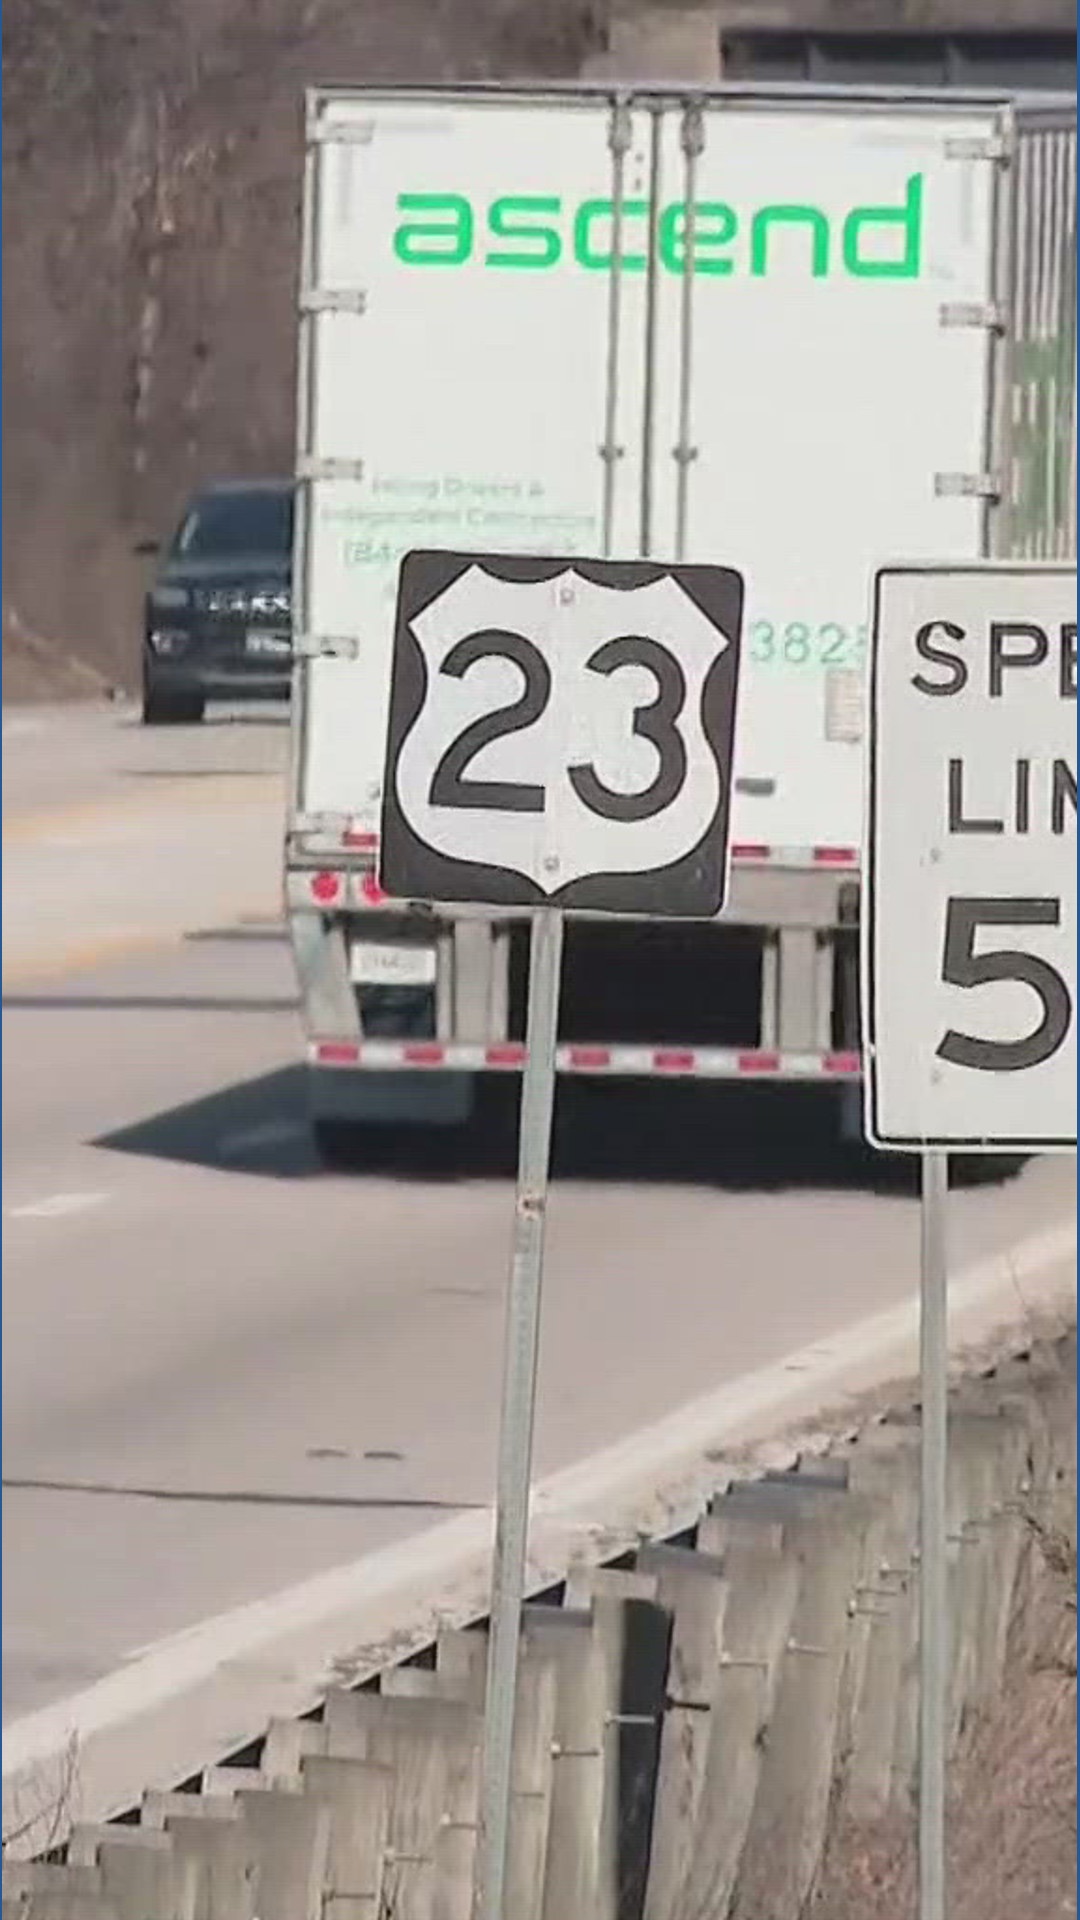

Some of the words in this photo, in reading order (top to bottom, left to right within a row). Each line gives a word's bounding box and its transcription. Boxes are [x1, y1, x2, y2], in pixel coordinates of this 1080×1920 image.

[393, 172, 922, 278] ascend
[429, 628, 687, 822] 23
[935, 897, 1071, 1071] 5
